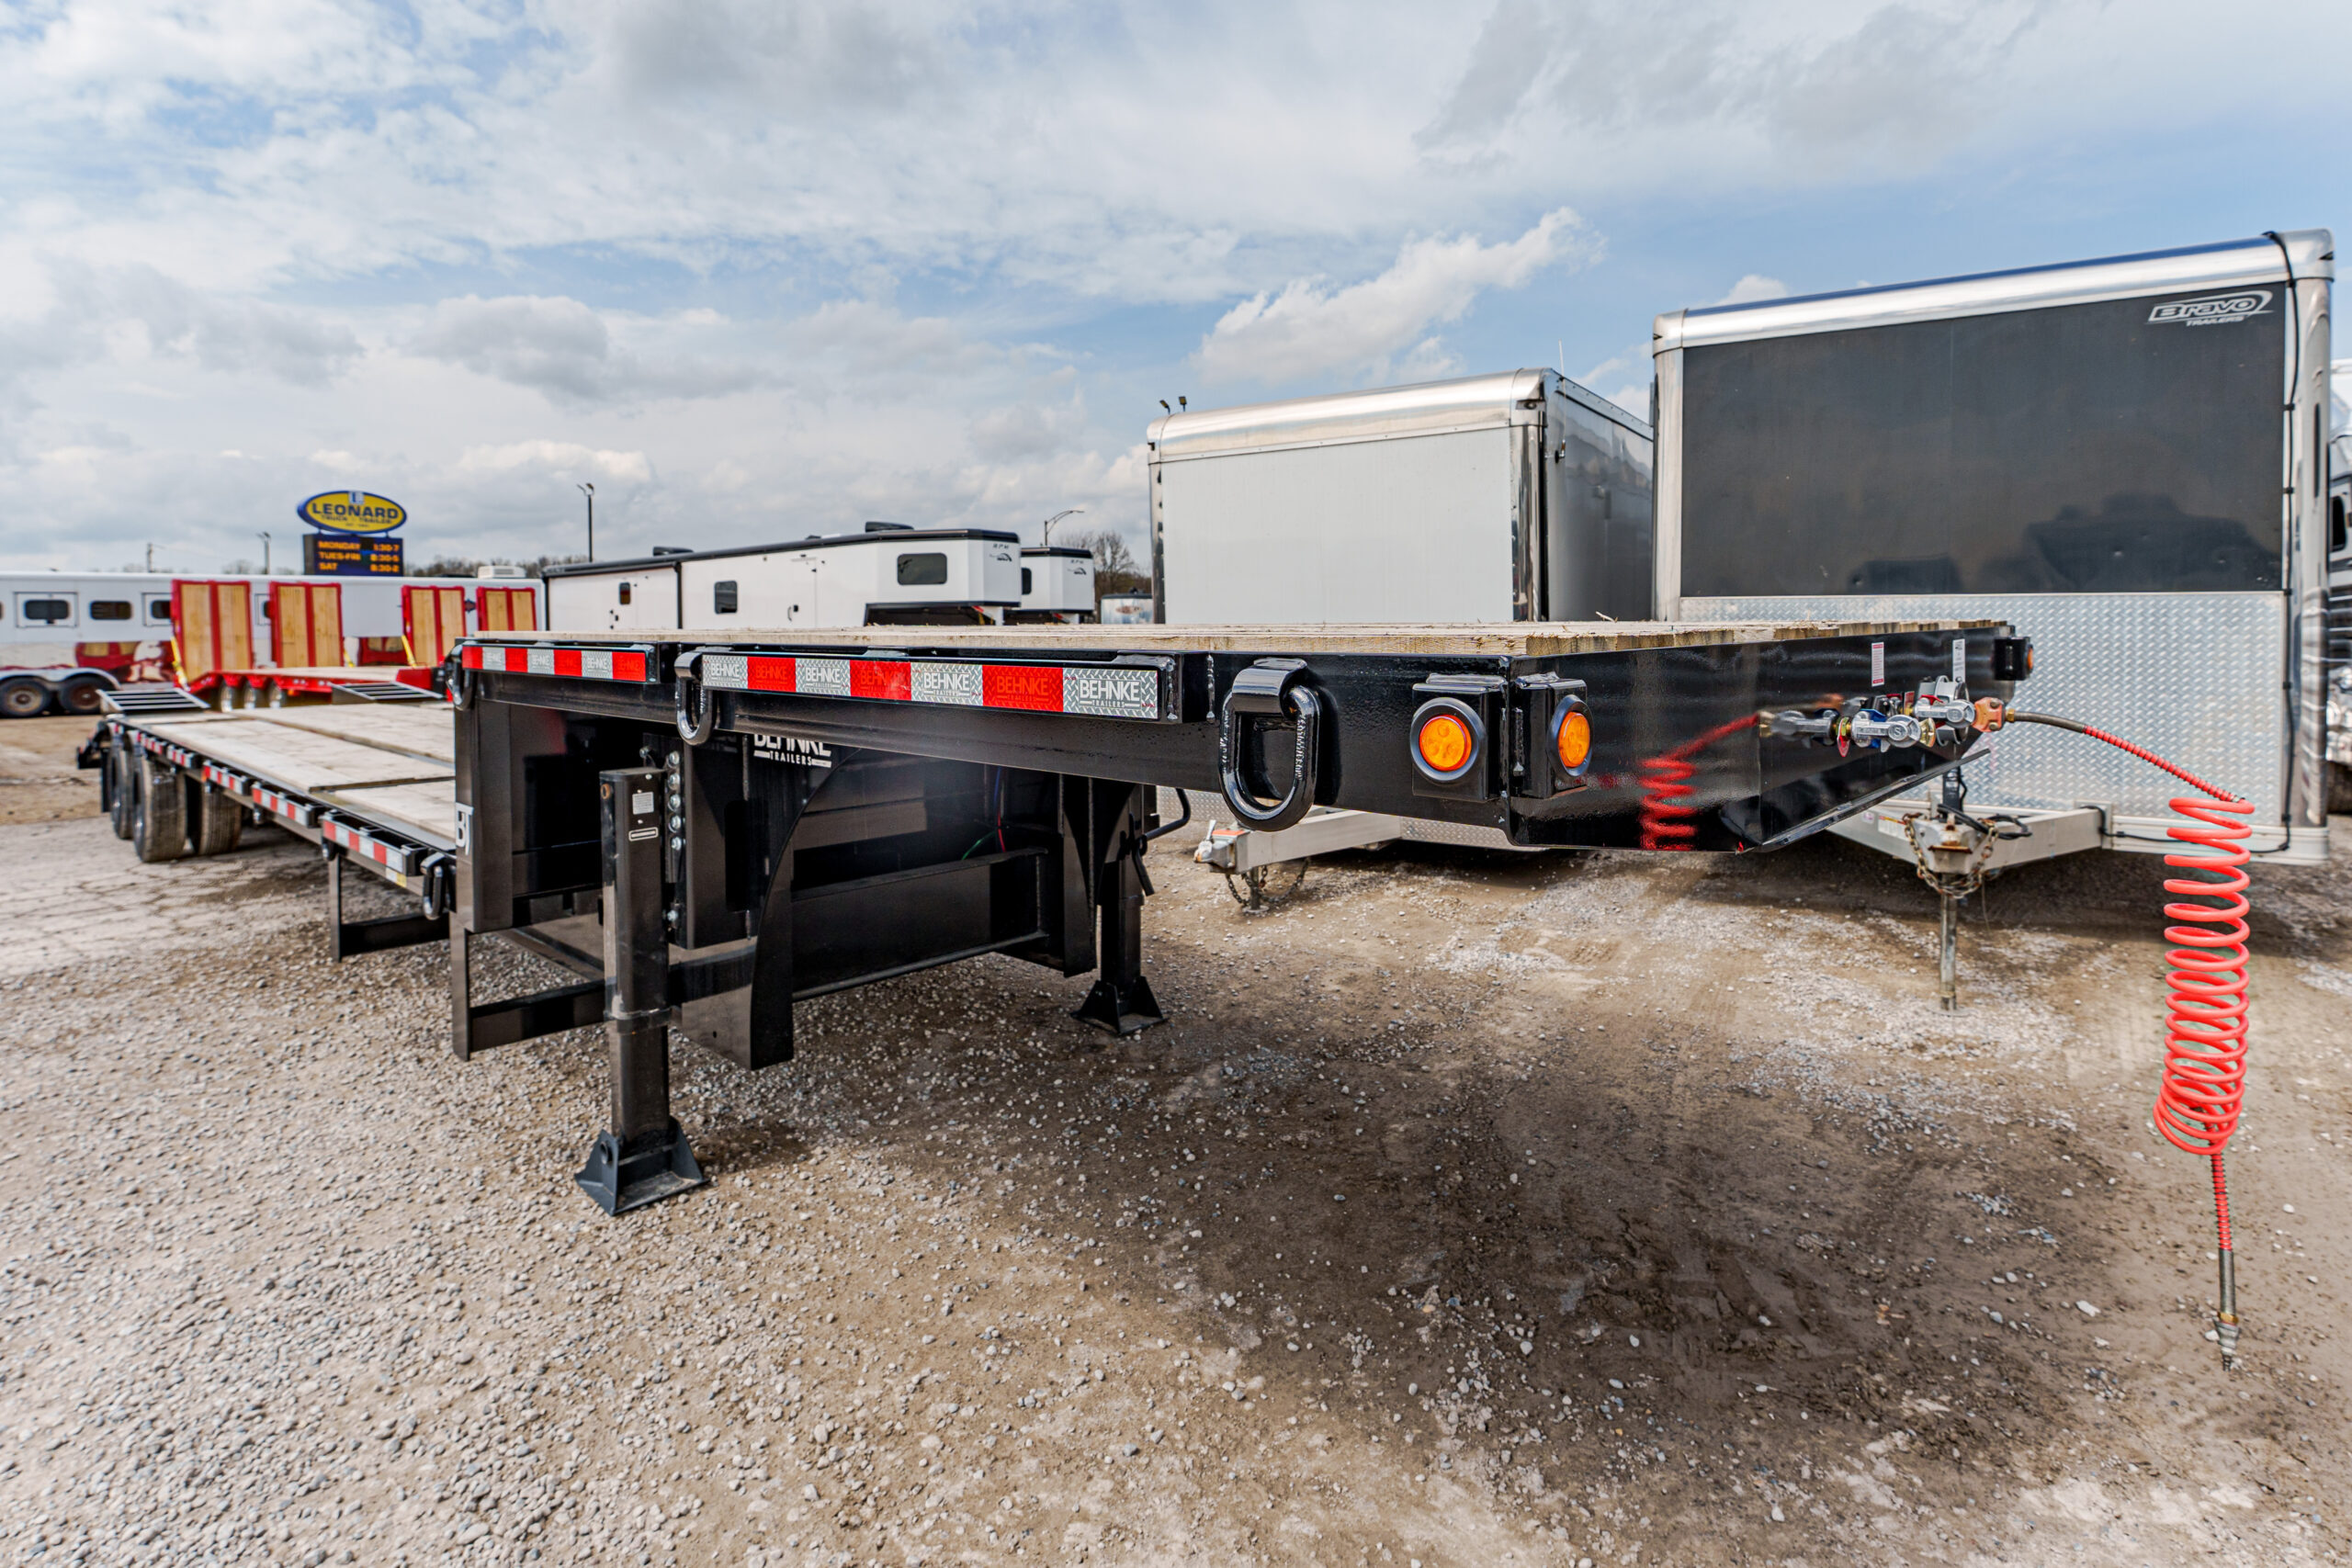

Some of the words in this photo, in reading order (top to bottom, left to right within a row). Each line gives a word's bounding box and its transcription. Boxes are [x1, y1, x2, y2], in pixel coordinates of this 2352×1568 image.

[2186, 316, 2245, 326] TRAILERS
[312, 502, 399, 519] LEONARD
[318, 540, 361, 550] MONDAY
[319, 562, 338, 570] SAT
[710, 663, 740, 677] BEHNKE
[805, 668, 841, 683] BEHNKE
[923, 672, 970, 691] BEHNKE
[996, 675, 1048, 696] BEHNKE
[1079, 679, 1141, 702] BEHNKE
[1091, 700, 1125, 708] TRAILERS
[769, 750, 812, 766] TRAILERS
